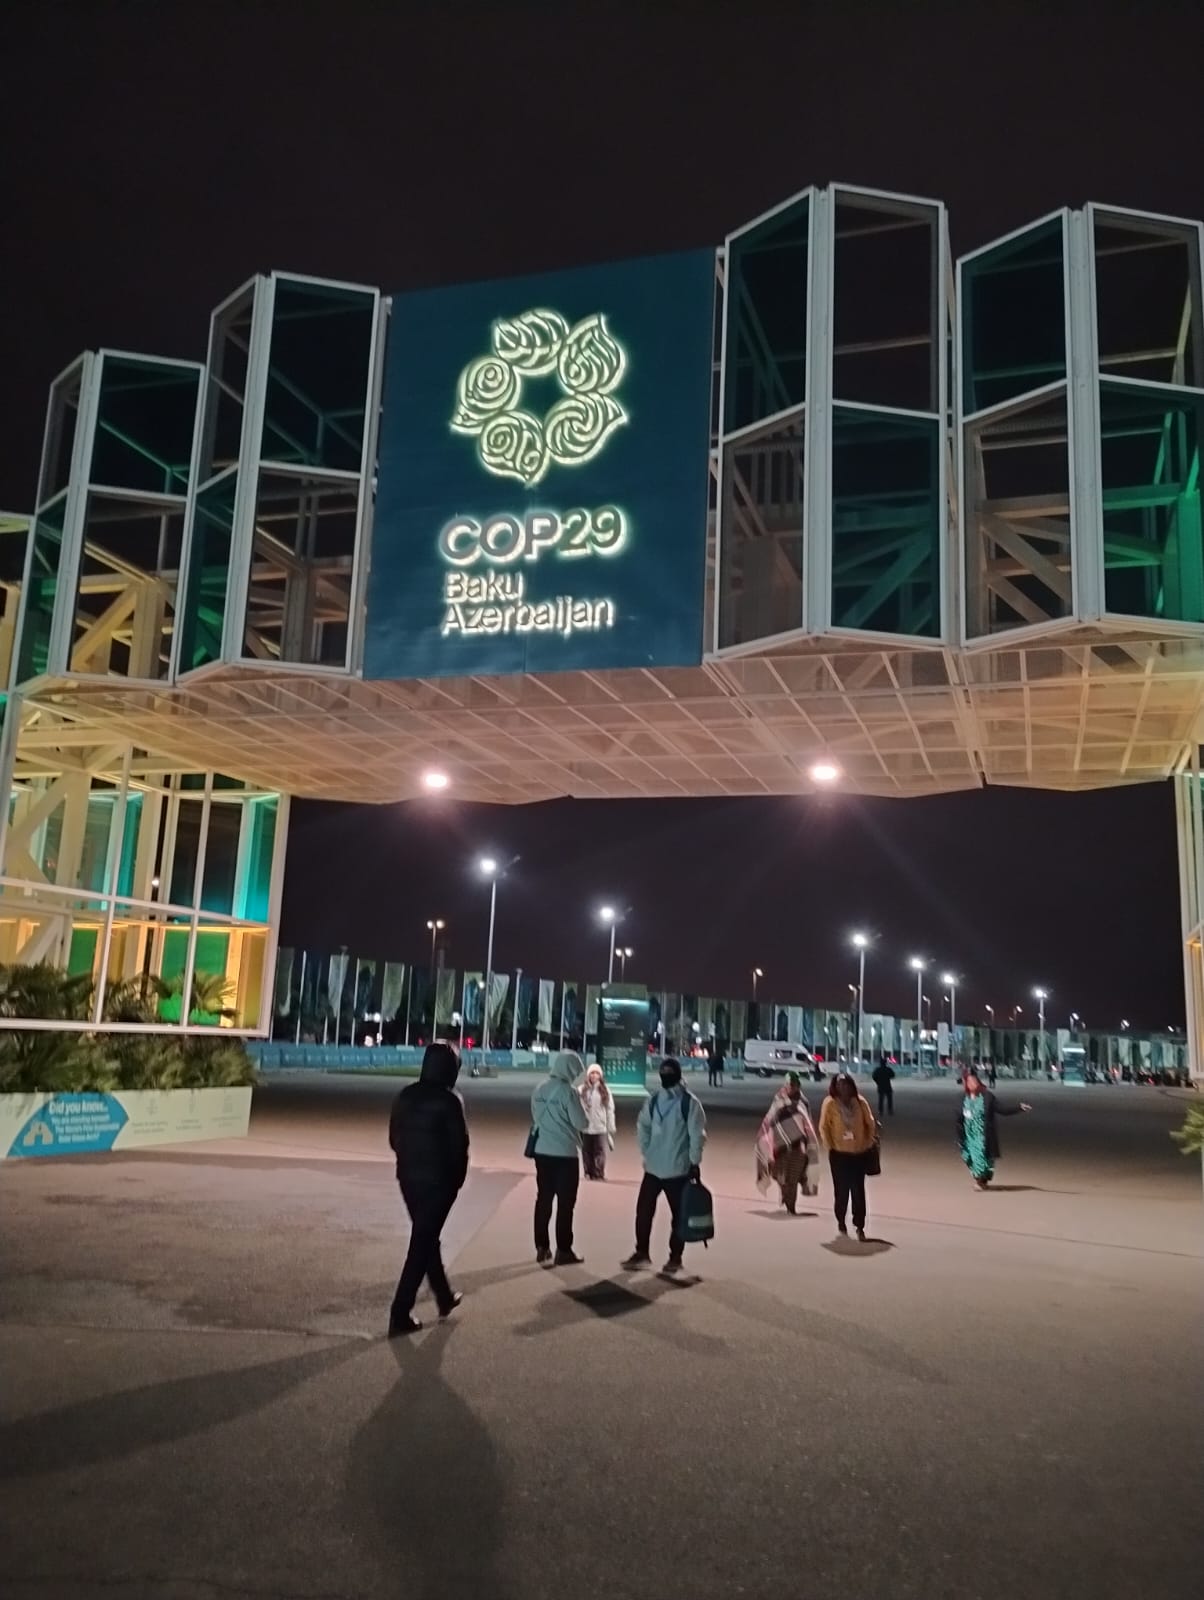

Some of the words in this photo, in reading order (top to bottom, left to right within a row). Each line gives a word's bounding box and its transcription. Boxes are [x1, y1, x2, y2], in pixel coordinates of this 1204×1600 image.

[438, 504, 626, 565] COP29
[445, 570, 524, 604] Baku
[441, 596, 615, 638] Azerbaijan
